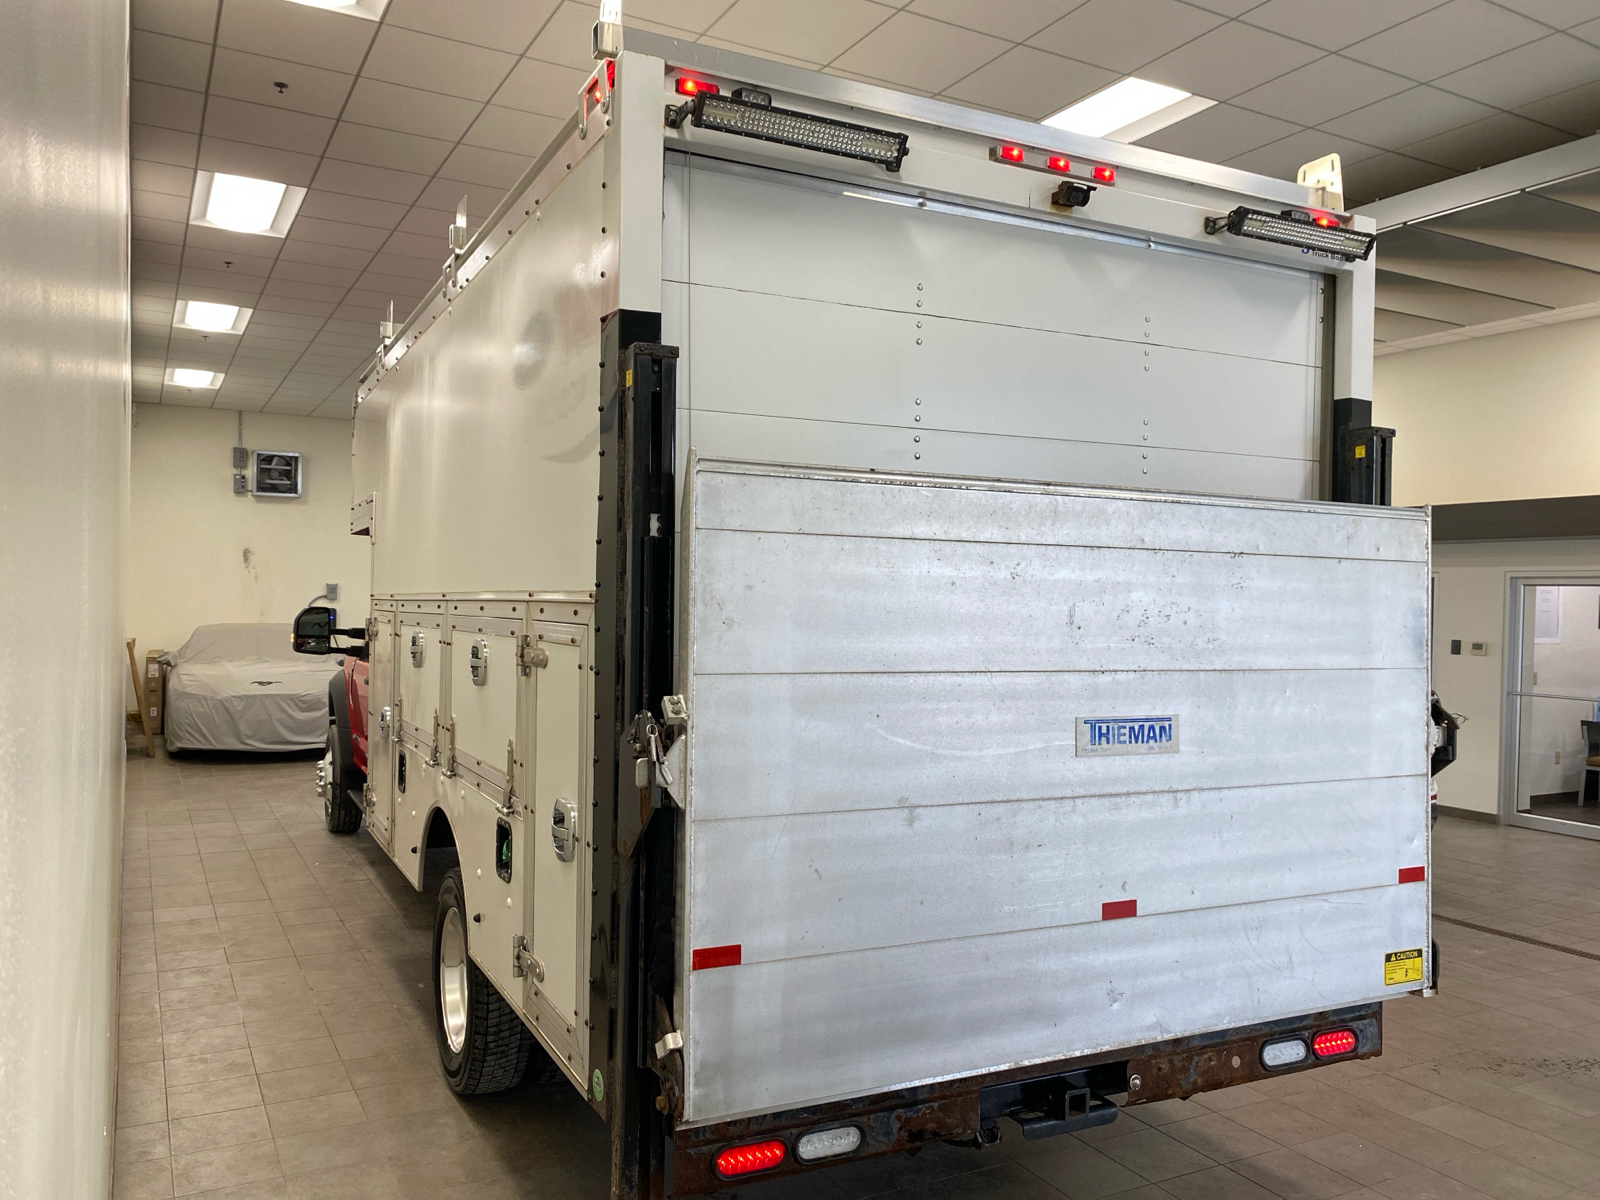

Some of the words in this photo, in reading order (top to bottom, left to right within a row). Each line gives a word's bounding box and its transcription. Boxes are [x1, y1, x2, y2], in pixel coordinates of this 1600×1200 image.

[1312, 250, 1329, 258] Truck
[1084, 717, 1172, 745] THIEMAN
[1397, 951, 1418, 960] CAUTION
